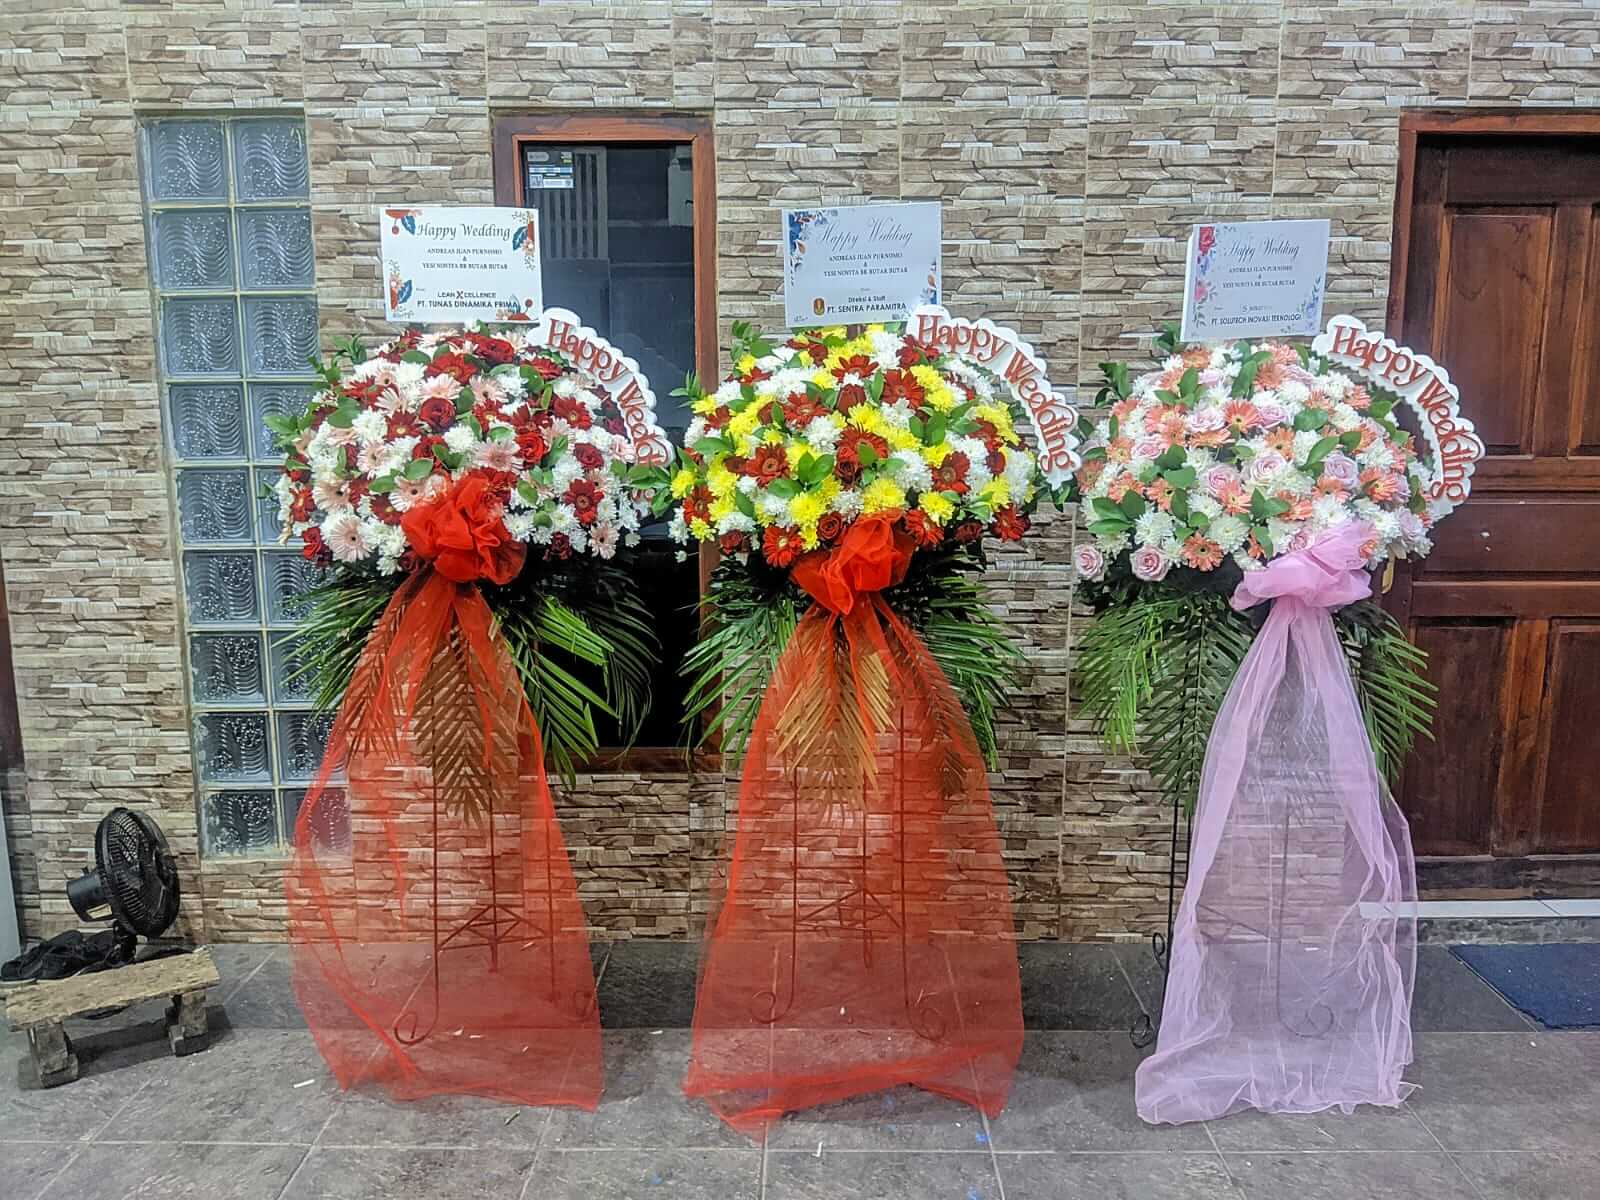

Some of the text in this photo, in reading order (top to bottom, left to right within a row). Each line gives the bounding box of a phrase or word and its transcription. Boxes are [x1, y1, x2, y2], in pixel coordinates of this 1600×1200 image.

[417, 223, 511, 241] Happy Wedding
[820, 217, 912, 251] Happy Wedding
[1226, 239, 1300, 262] Happy Wedding
[454, 300, 493, 308] DINAMIKA
[494, 300, 518, 308] PRIMA
[838, 304, 864, 313] SENTRA
[866, 302, 907, 312] PARAMITRA
[546, 318, 669, 465] Happy Weddi
[916, 314, 1075, 474] Happy Wedding
[1328, 324, 1481, 501] Happy Wedding
